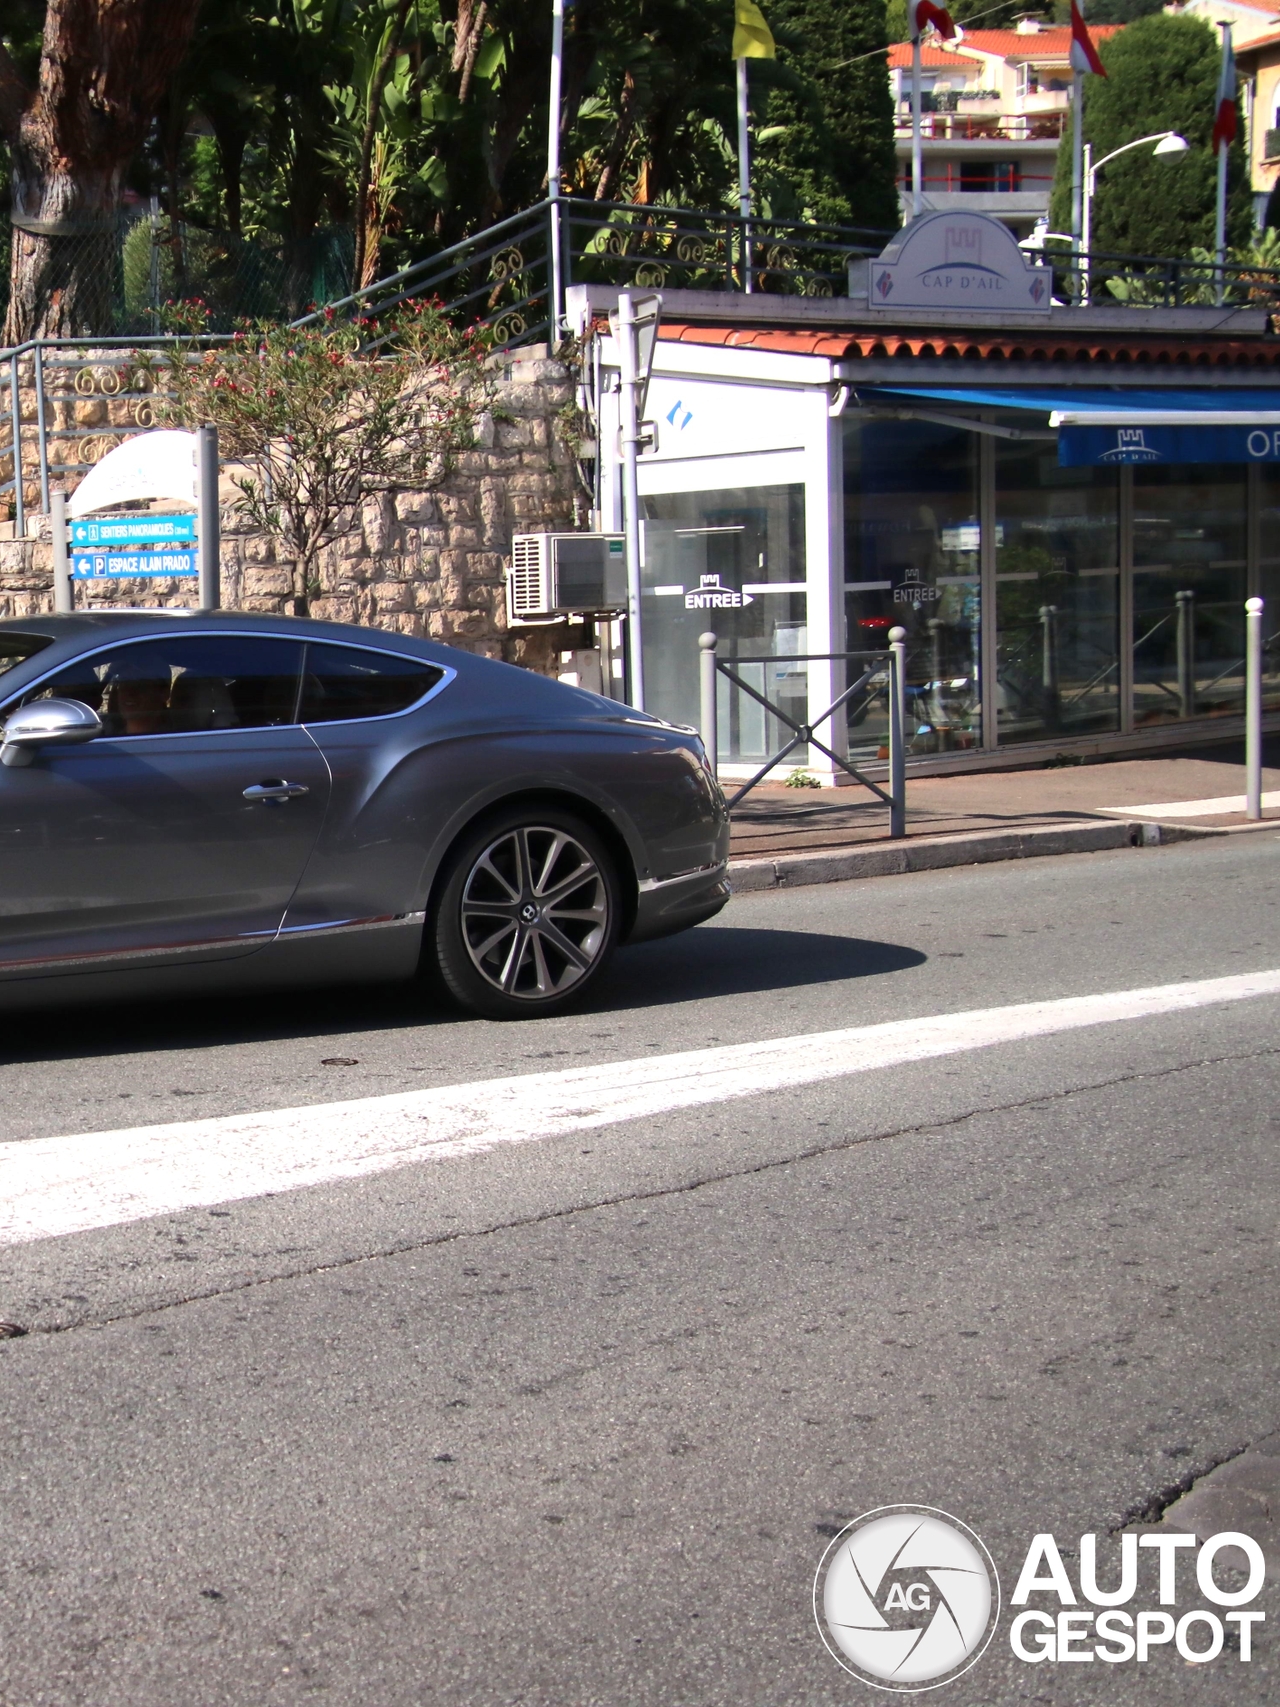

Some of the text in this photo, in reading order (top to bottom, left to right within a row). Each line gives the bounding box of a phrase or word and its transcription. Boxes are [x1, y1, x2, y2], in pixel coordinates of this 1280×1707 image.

[922, 275, 1003, 290] CAP D'AIL
[100, 525, 128, 539] SENTIERS
[108, 554, 191, 573] ESPACE ALAIN PRADO
[685, 593, 742, 609] ENTREE
[893, 588, 935, 603] ENTREE
